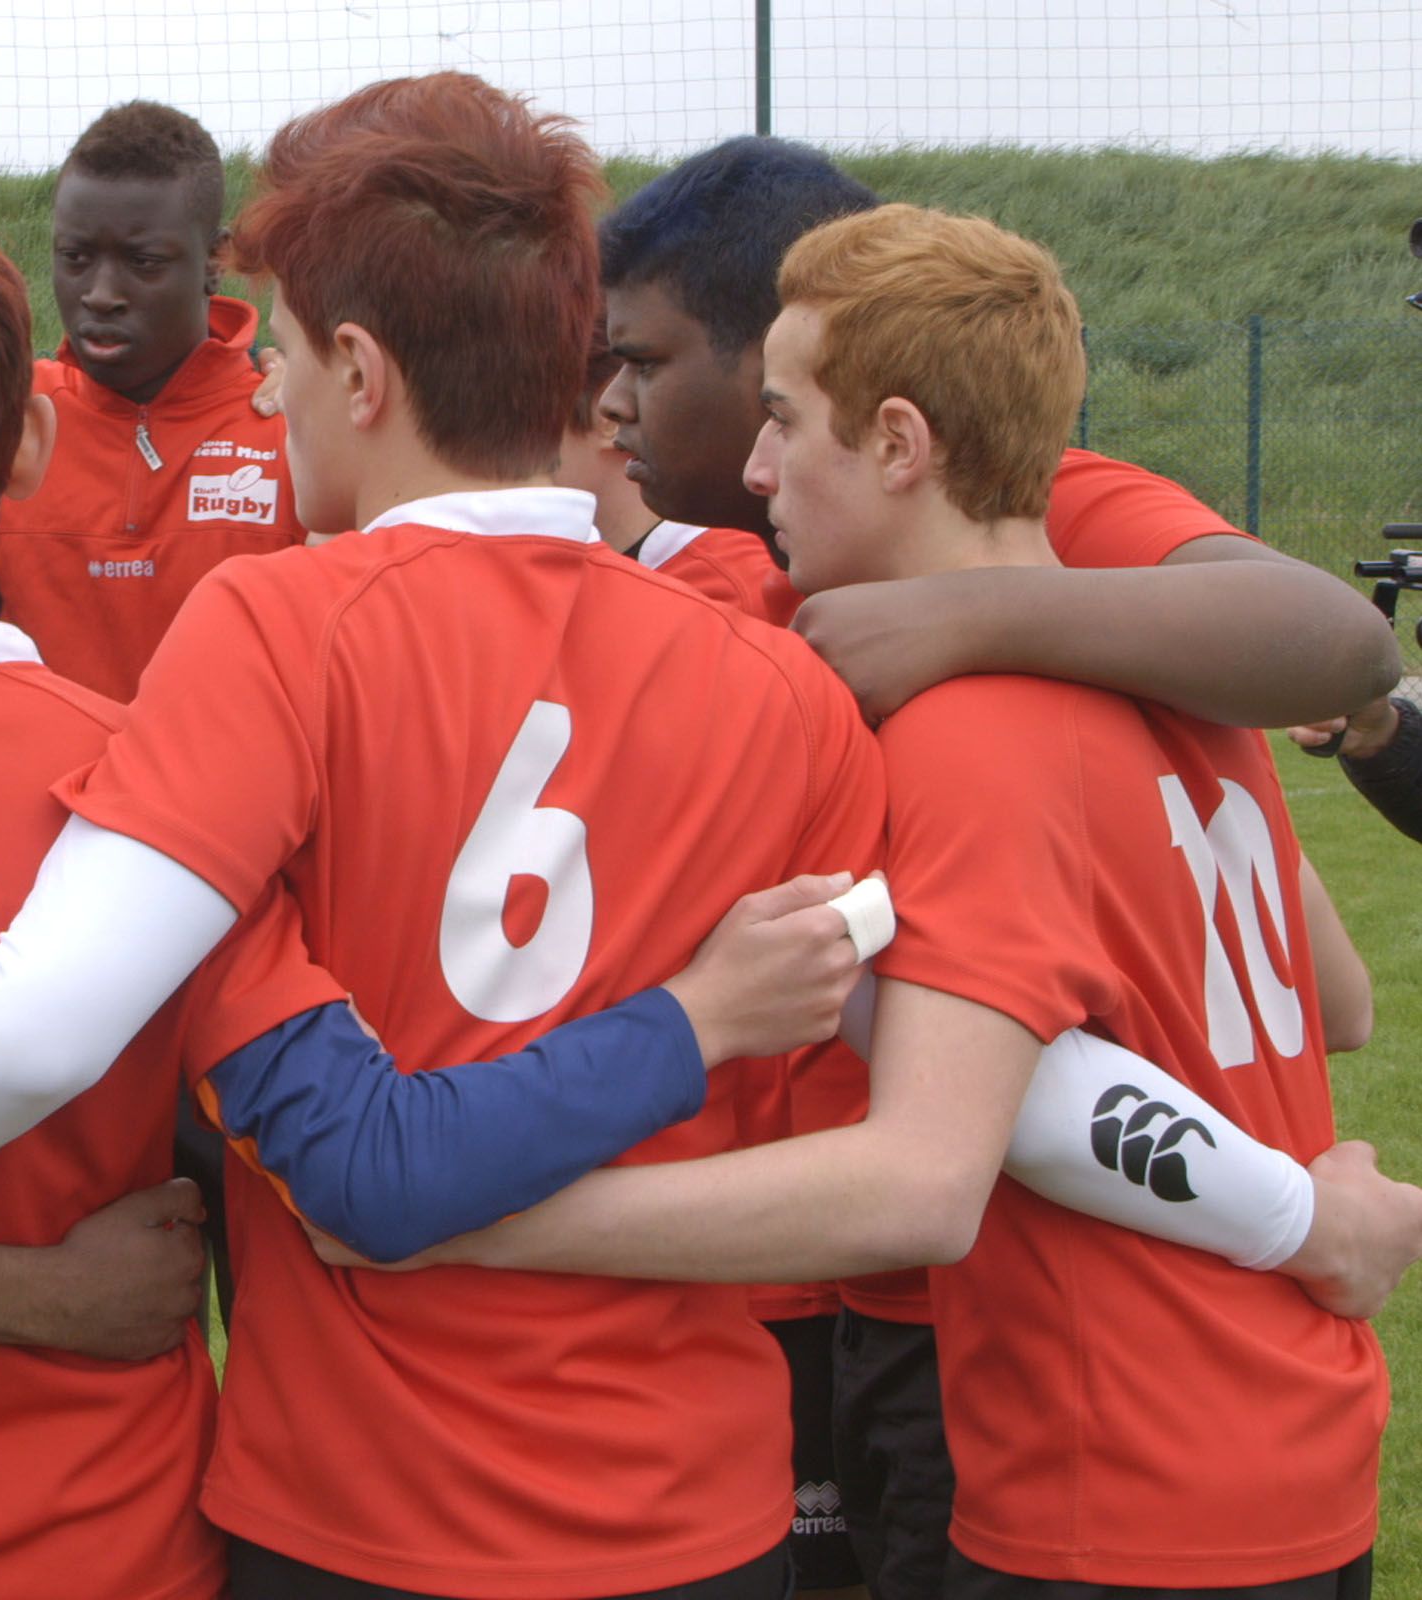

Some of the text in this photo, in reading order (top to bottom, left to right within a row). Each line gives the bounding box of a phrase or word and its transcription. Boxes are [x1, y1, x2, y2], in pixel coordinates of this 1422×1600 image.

[193, 496, 273, 519] Rugby
[439, 699, 594, 1023] 6
[1158, 774, 1304, 1070] 10
